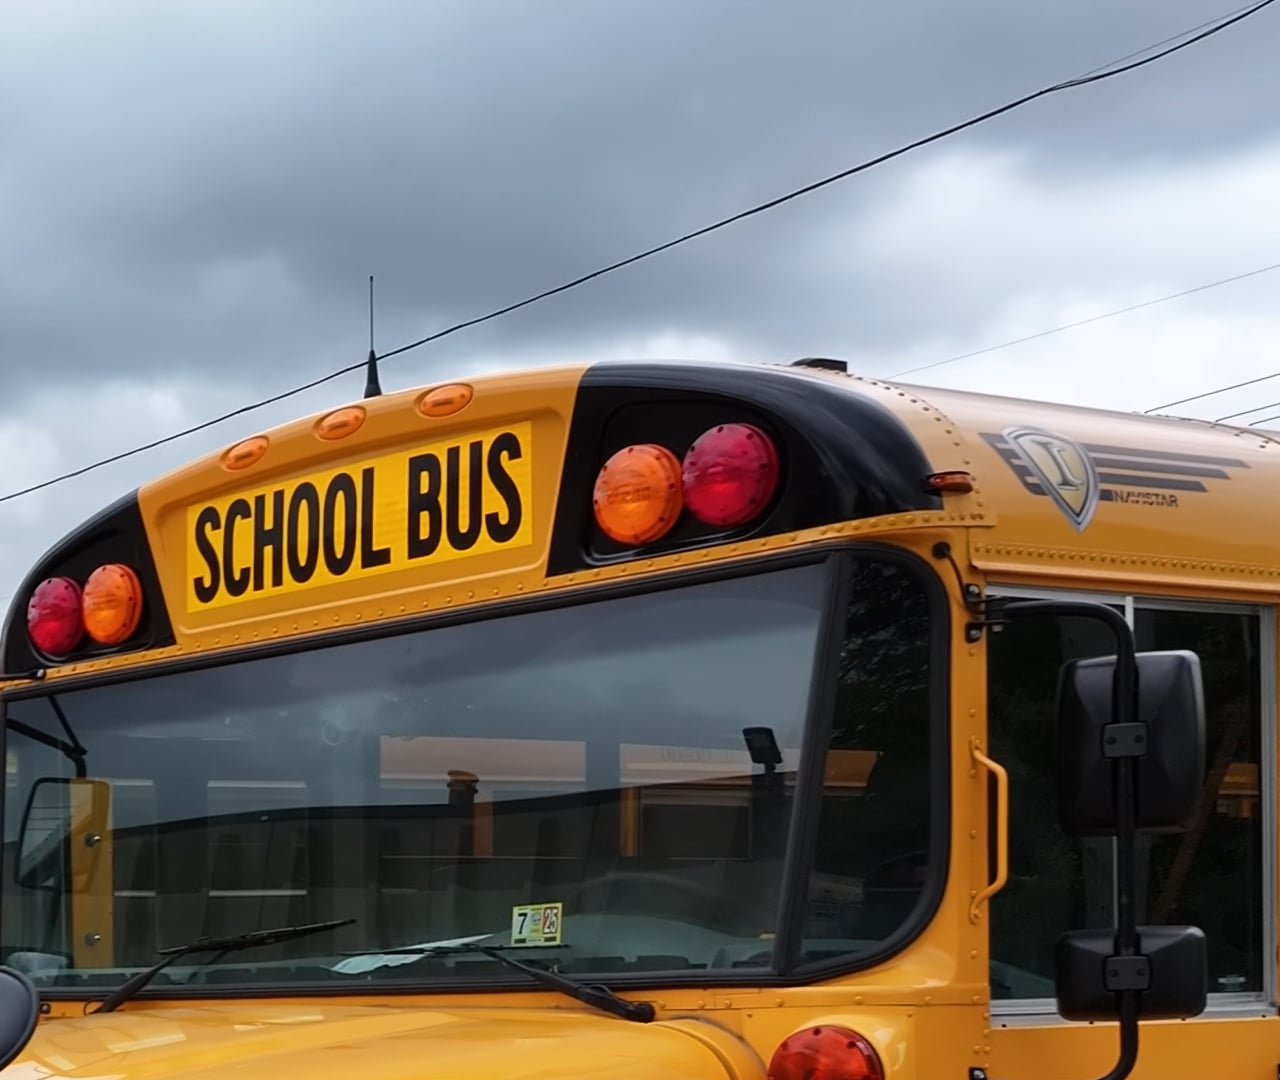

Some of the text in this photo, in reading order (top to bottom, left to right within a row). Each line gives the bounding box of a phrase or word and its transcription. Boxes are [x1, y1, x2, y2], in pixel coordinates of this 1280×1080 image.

[1113, 489, 1179, 508] NAVISTAR
[193, 431, 523, 604] SCHOOL BUS
[518, 908, 558, 935] 7 25
